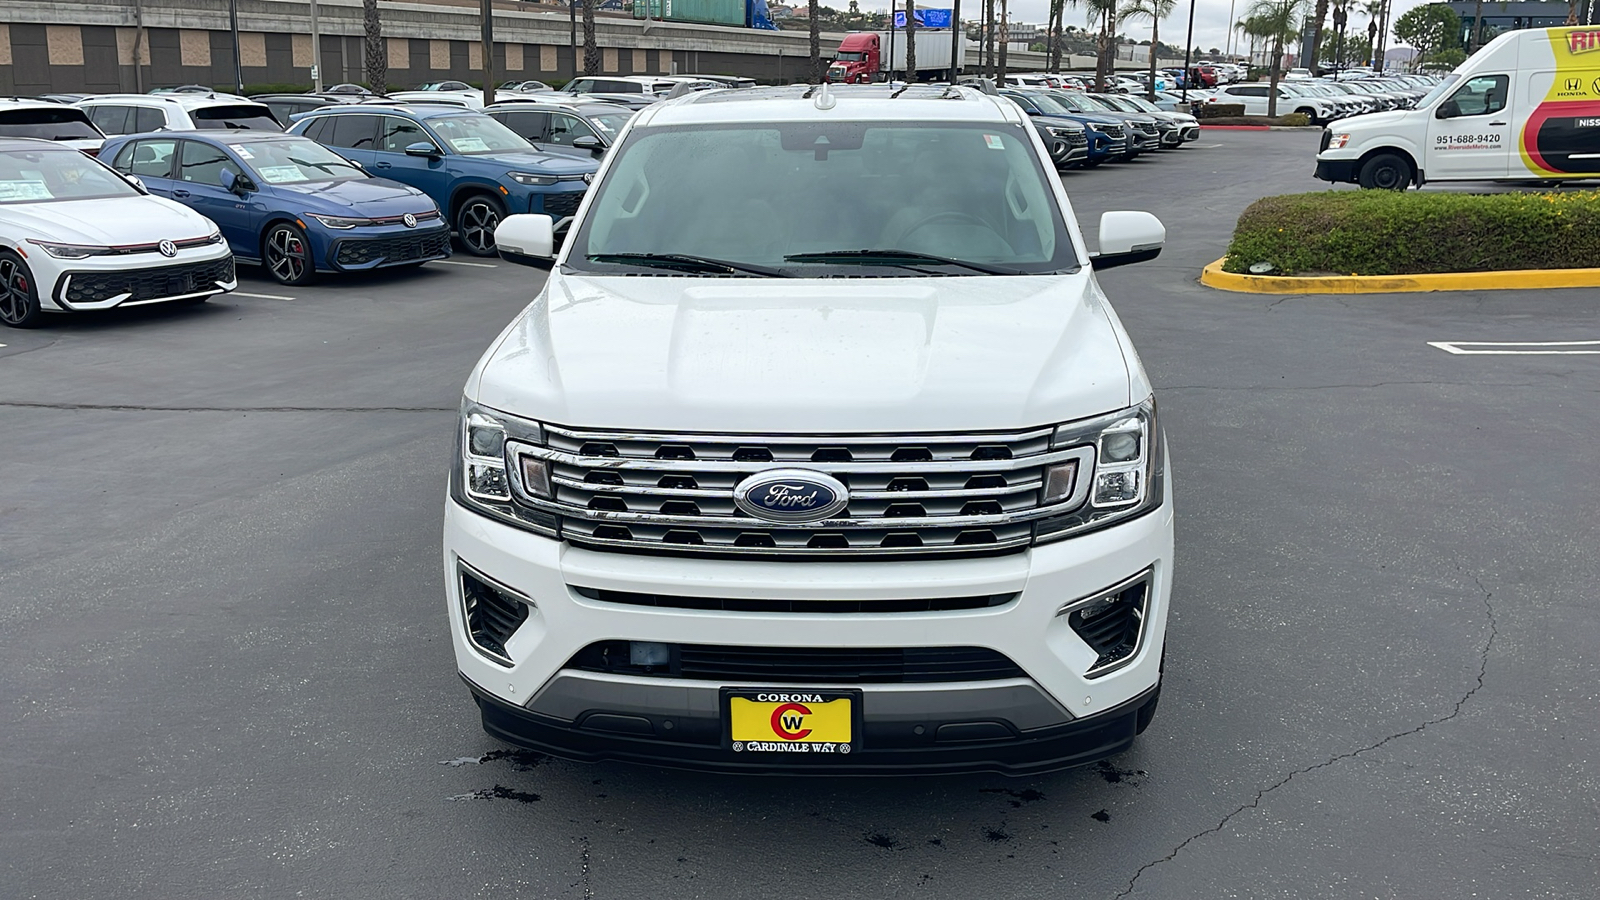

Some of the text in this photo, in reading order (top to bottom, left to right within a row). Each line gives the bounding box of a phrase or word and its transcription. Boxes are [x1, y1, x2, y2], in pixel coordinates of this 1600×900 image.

[1436, 134, 1501, 144] 951-688-9420
[764, 484, 818, 507] Ford
[757, 693, 824, 702] CORONA
[746, 742, 837, 753] CARDINALE WAY
